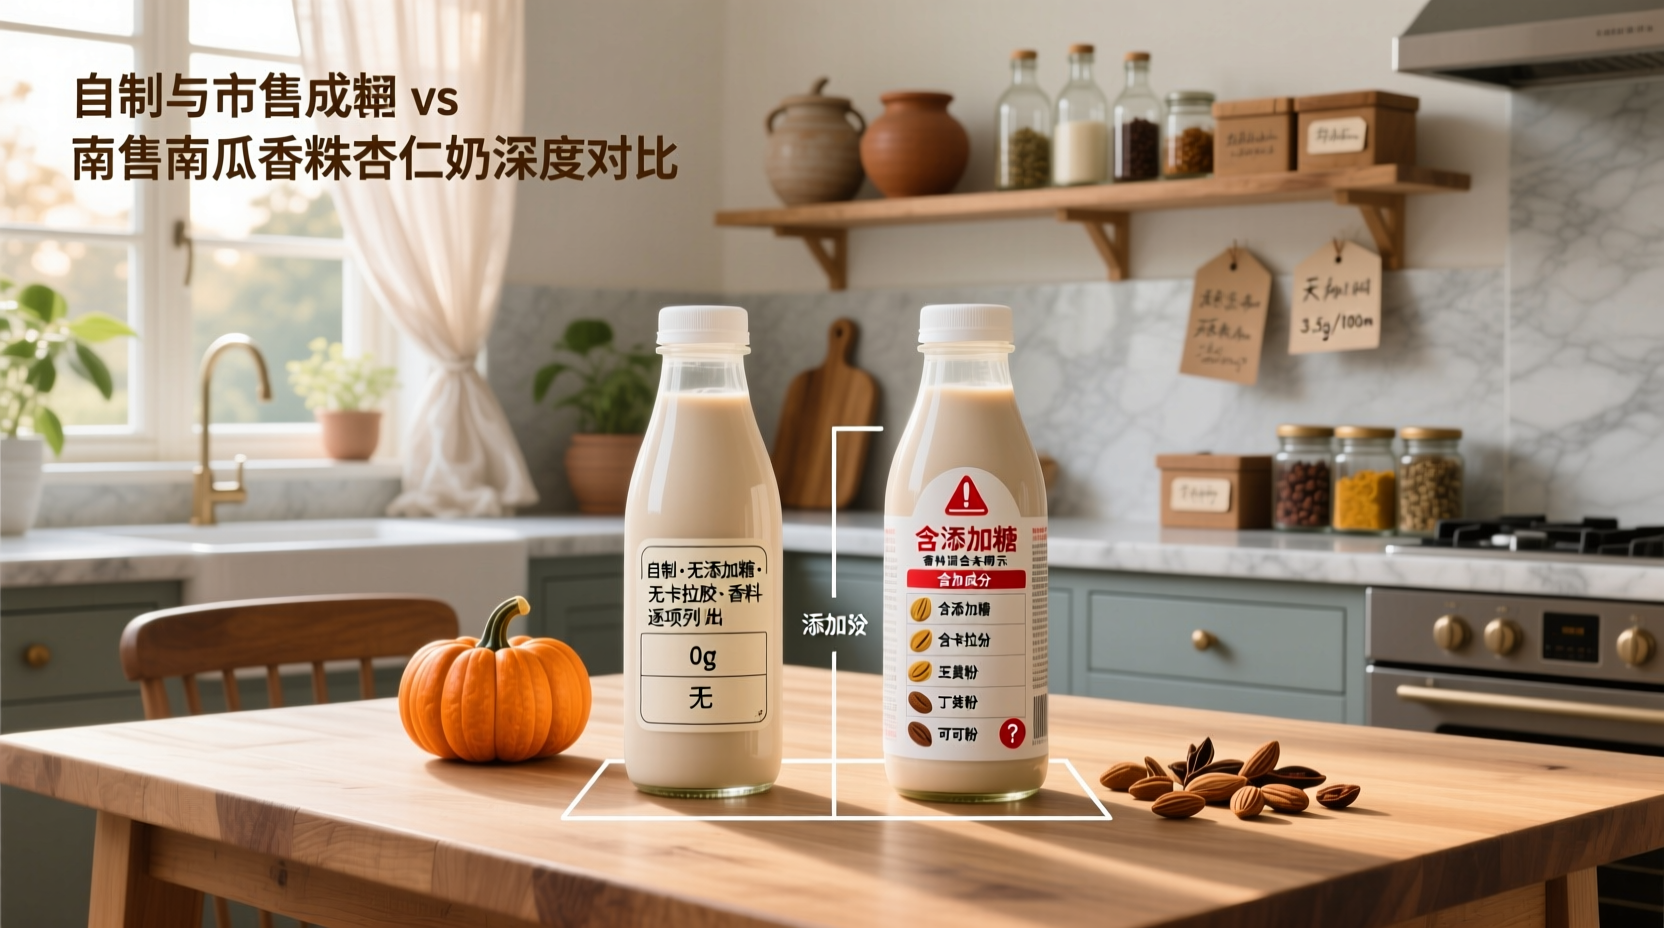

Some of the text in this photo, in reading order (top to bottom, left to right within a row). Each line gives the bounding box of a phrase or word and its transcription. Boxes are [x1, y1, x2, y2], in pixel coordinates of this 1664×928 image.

[915, 525, 1018, 553] 含添加糖
[689, 645, 717, 672] 0g
[689, 686, 713, 709] 无
[938, 727, 979, 742] 可可粉
